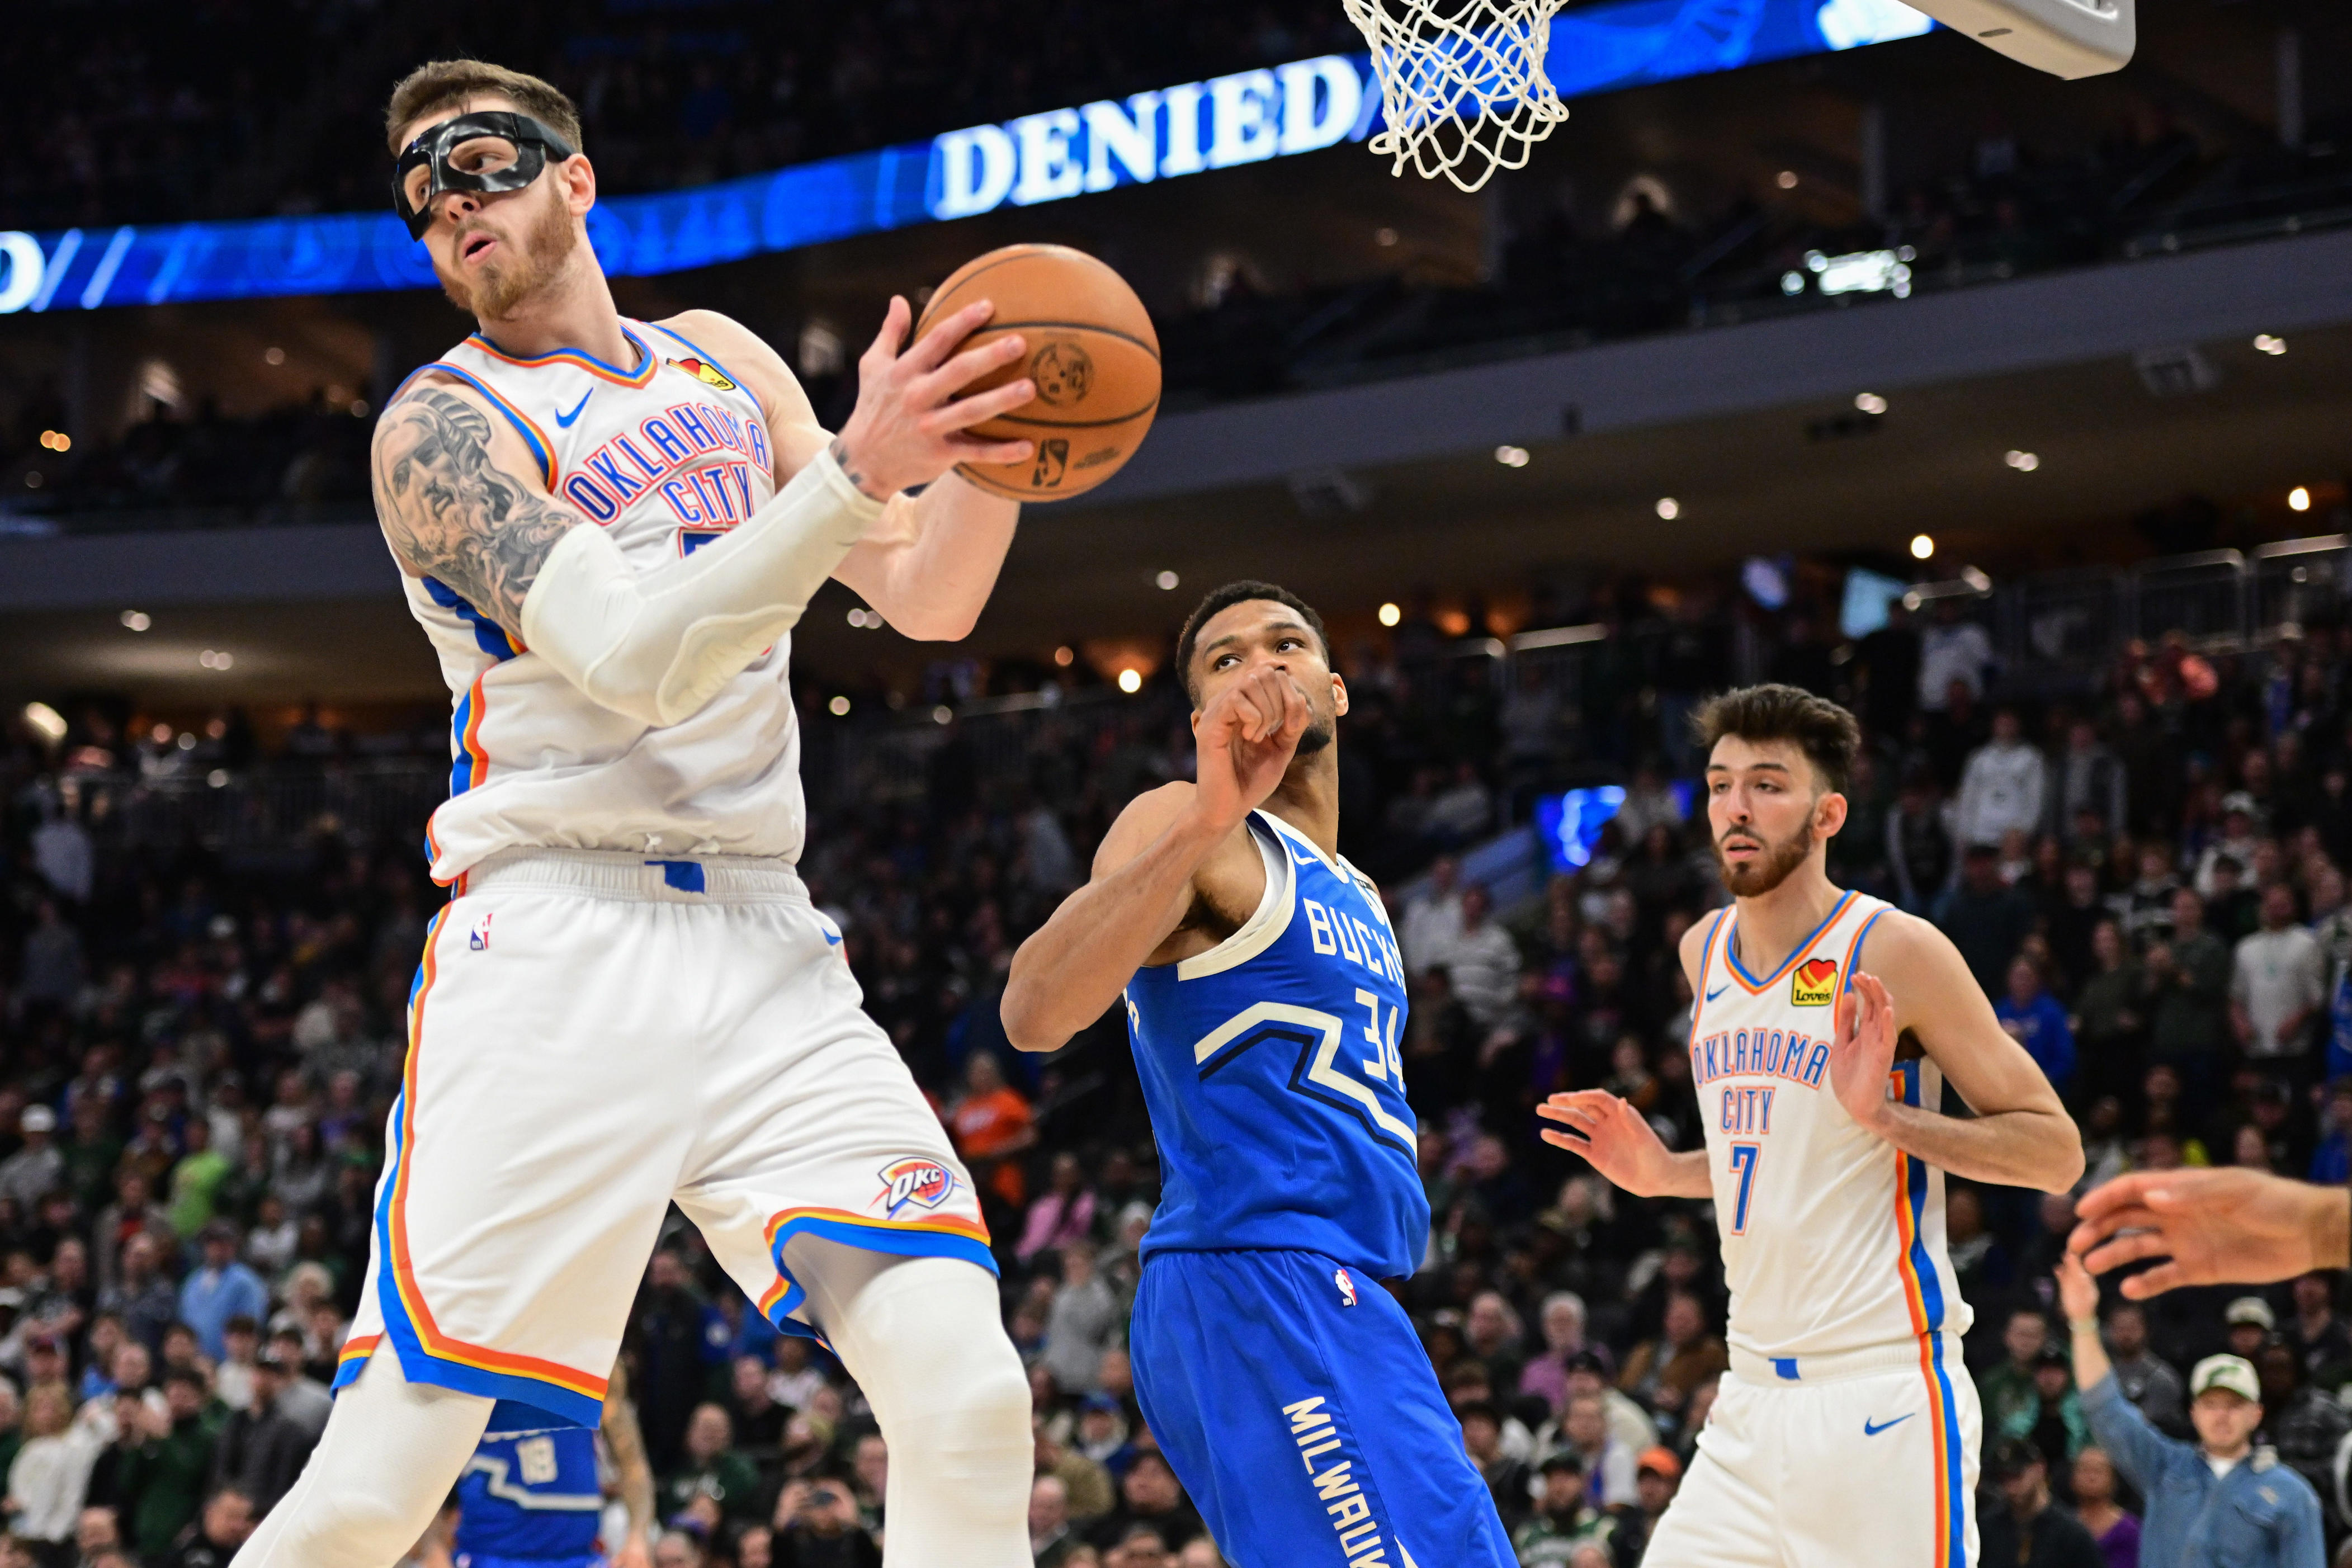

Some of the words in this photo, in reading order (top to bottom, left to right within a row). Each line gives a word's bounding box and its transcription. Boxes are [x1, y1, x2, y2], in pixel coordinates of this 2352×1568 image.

[933, 54, 1363, 221] DENIED
[564, 402, 772, 526] OKLAHOMA
[658, 461, 755, 527] CITY
[1356, 988, 1404, 1093] 34
[1693, 1028, 1833, 1090] OKLAHOMA
[1720, 1086, 1776, 1135] CITY
[887, 1168, 941, 1210] OKC
[1730, 1141, 1761, 1236] 7
[1343, 1297, 1352, 1306] NBA
